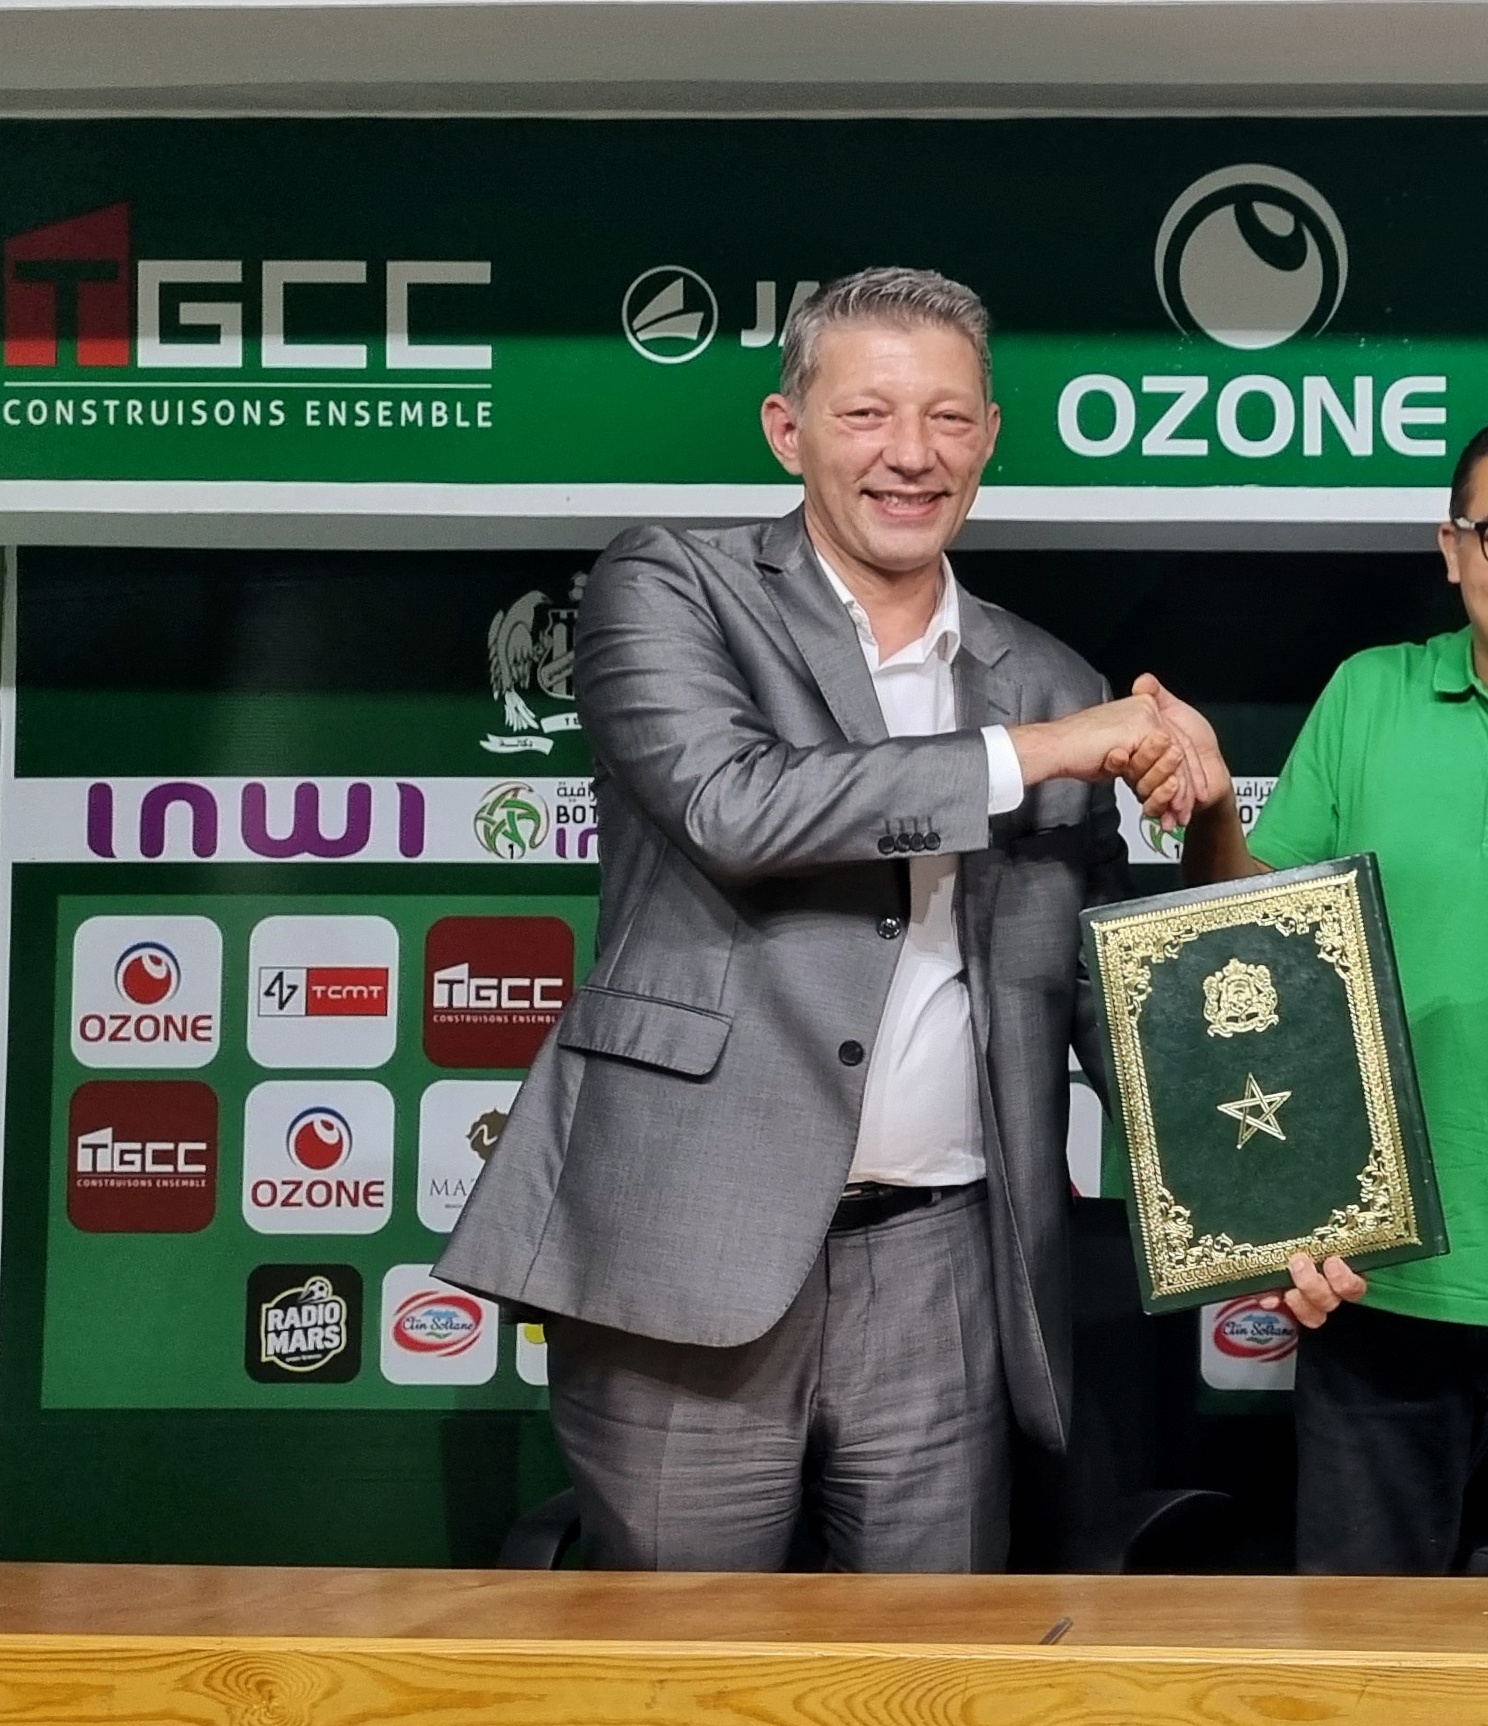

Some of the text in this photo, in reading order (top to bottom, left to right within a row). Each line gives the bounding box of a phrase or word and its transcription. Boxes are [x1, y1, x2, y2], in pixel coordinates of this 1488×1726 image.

[3, 399, 493, 428] CONSTRUISONS ENSEMBLE
[1058, 374, 1447, 457] OZONE
[311, 985, 384, 999] TCMT
[79, 1014, 213, 1042] OZONE
[433, 1014, 556, 1024] CONSTRUISONS ENSEMBL
[76, 1179, 206, 1188] CONSTRUISONS ENSEMBLE
[251, 1180, 385, 1208] OZONE
[267, 1301, 341, 1331] RADIO
[266, 1325, 341, 1355] MARS
